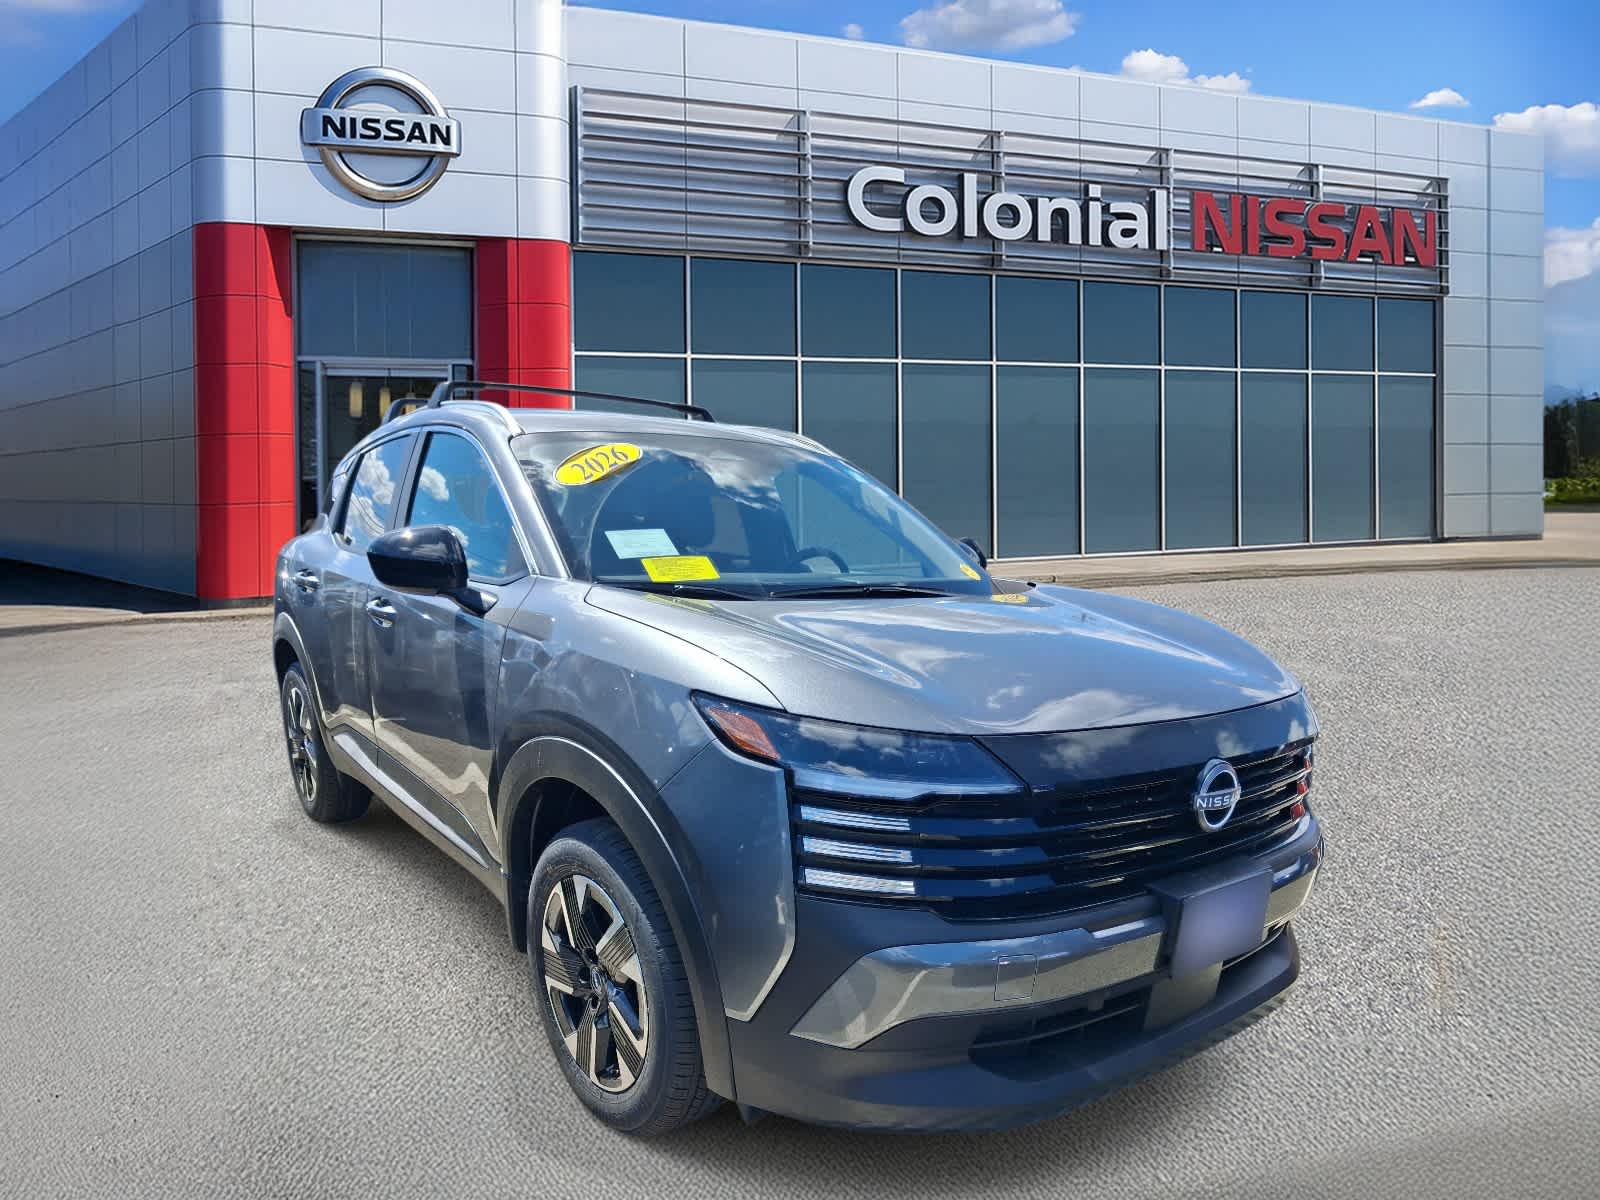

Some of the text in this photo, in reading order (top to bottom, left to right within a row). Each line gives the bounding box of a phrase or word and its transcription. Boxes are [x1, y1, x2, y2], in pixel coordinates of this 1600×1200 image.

[322, 115, 451, 146] NISSAN
[847, 166, 1436, 267] Colonial NISSAN
[571, 447, 629, 480] 2026
[1196, 790, 1238, 808] NISS
